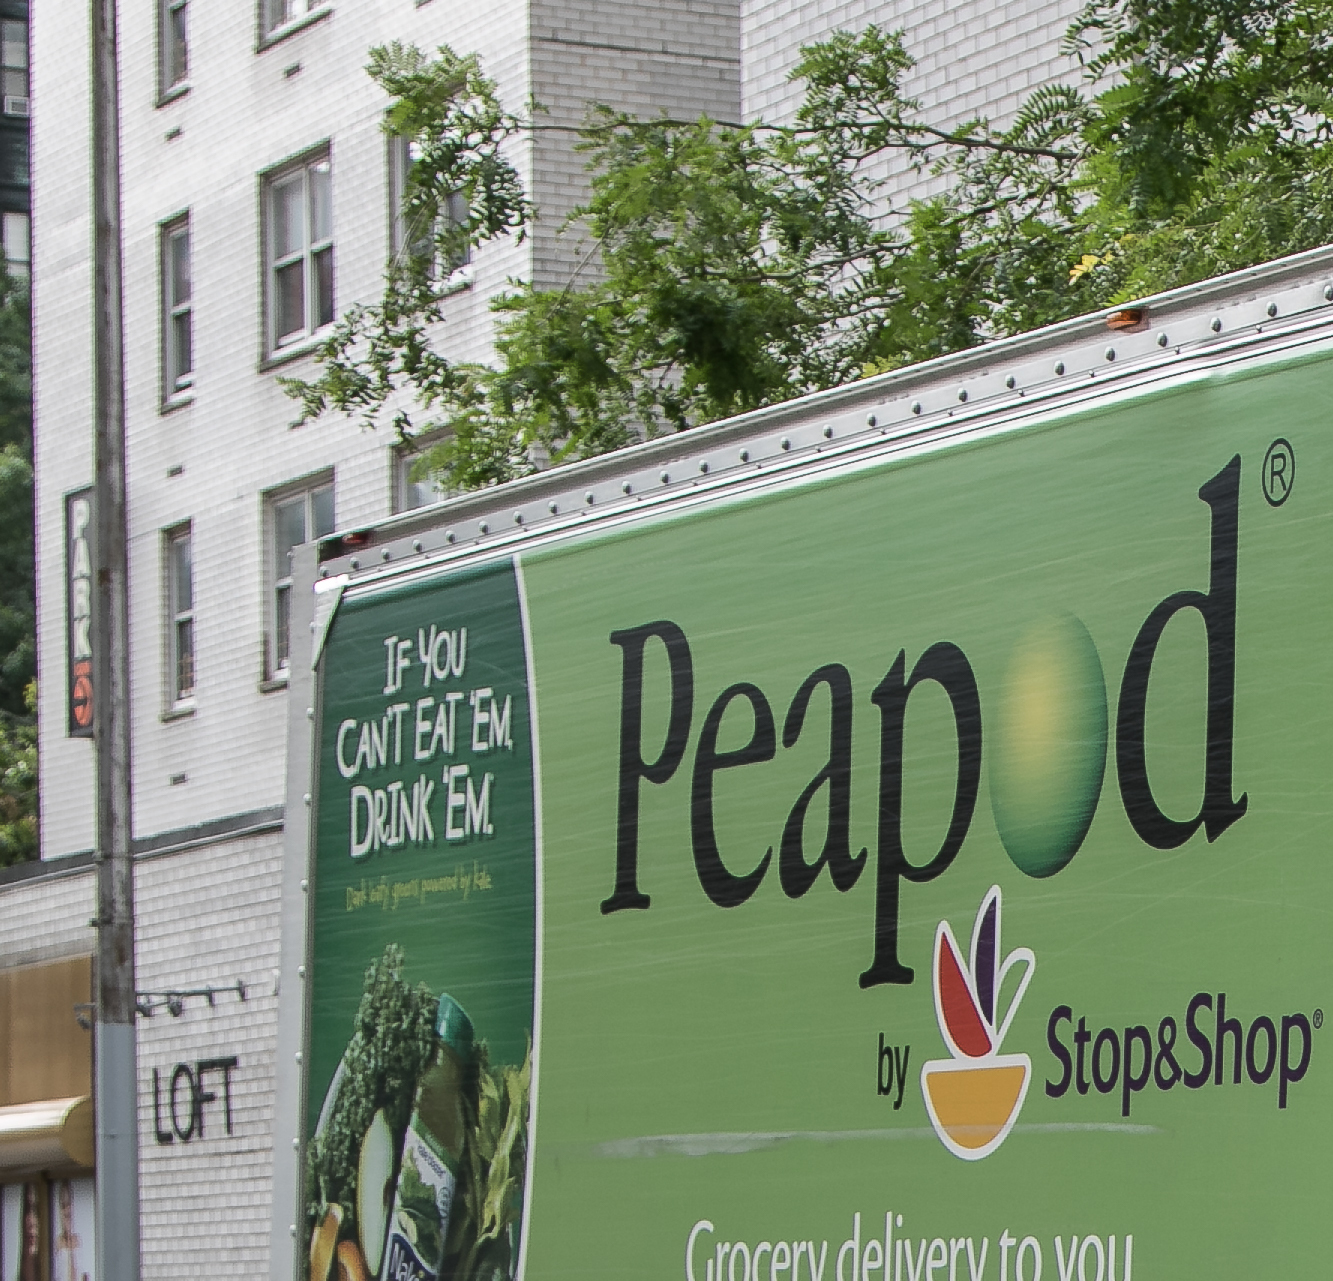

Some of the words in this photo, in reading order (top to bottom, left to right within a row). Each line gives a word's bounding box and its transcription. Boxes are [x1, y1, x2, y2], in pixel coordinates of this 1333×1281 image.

[73, 499, 92, 658] PARK
[383, 635, 413, 696] IF
[418, 624, 468, 688] YOU
[336, 702, 411, 778] CAN'T
[414, 692, 464, 760] EAT
[350, 773, 434, 858] DRINK
[152, 1055, 238, 1145] LOFT
[877, 1032, 910, 1110] by
